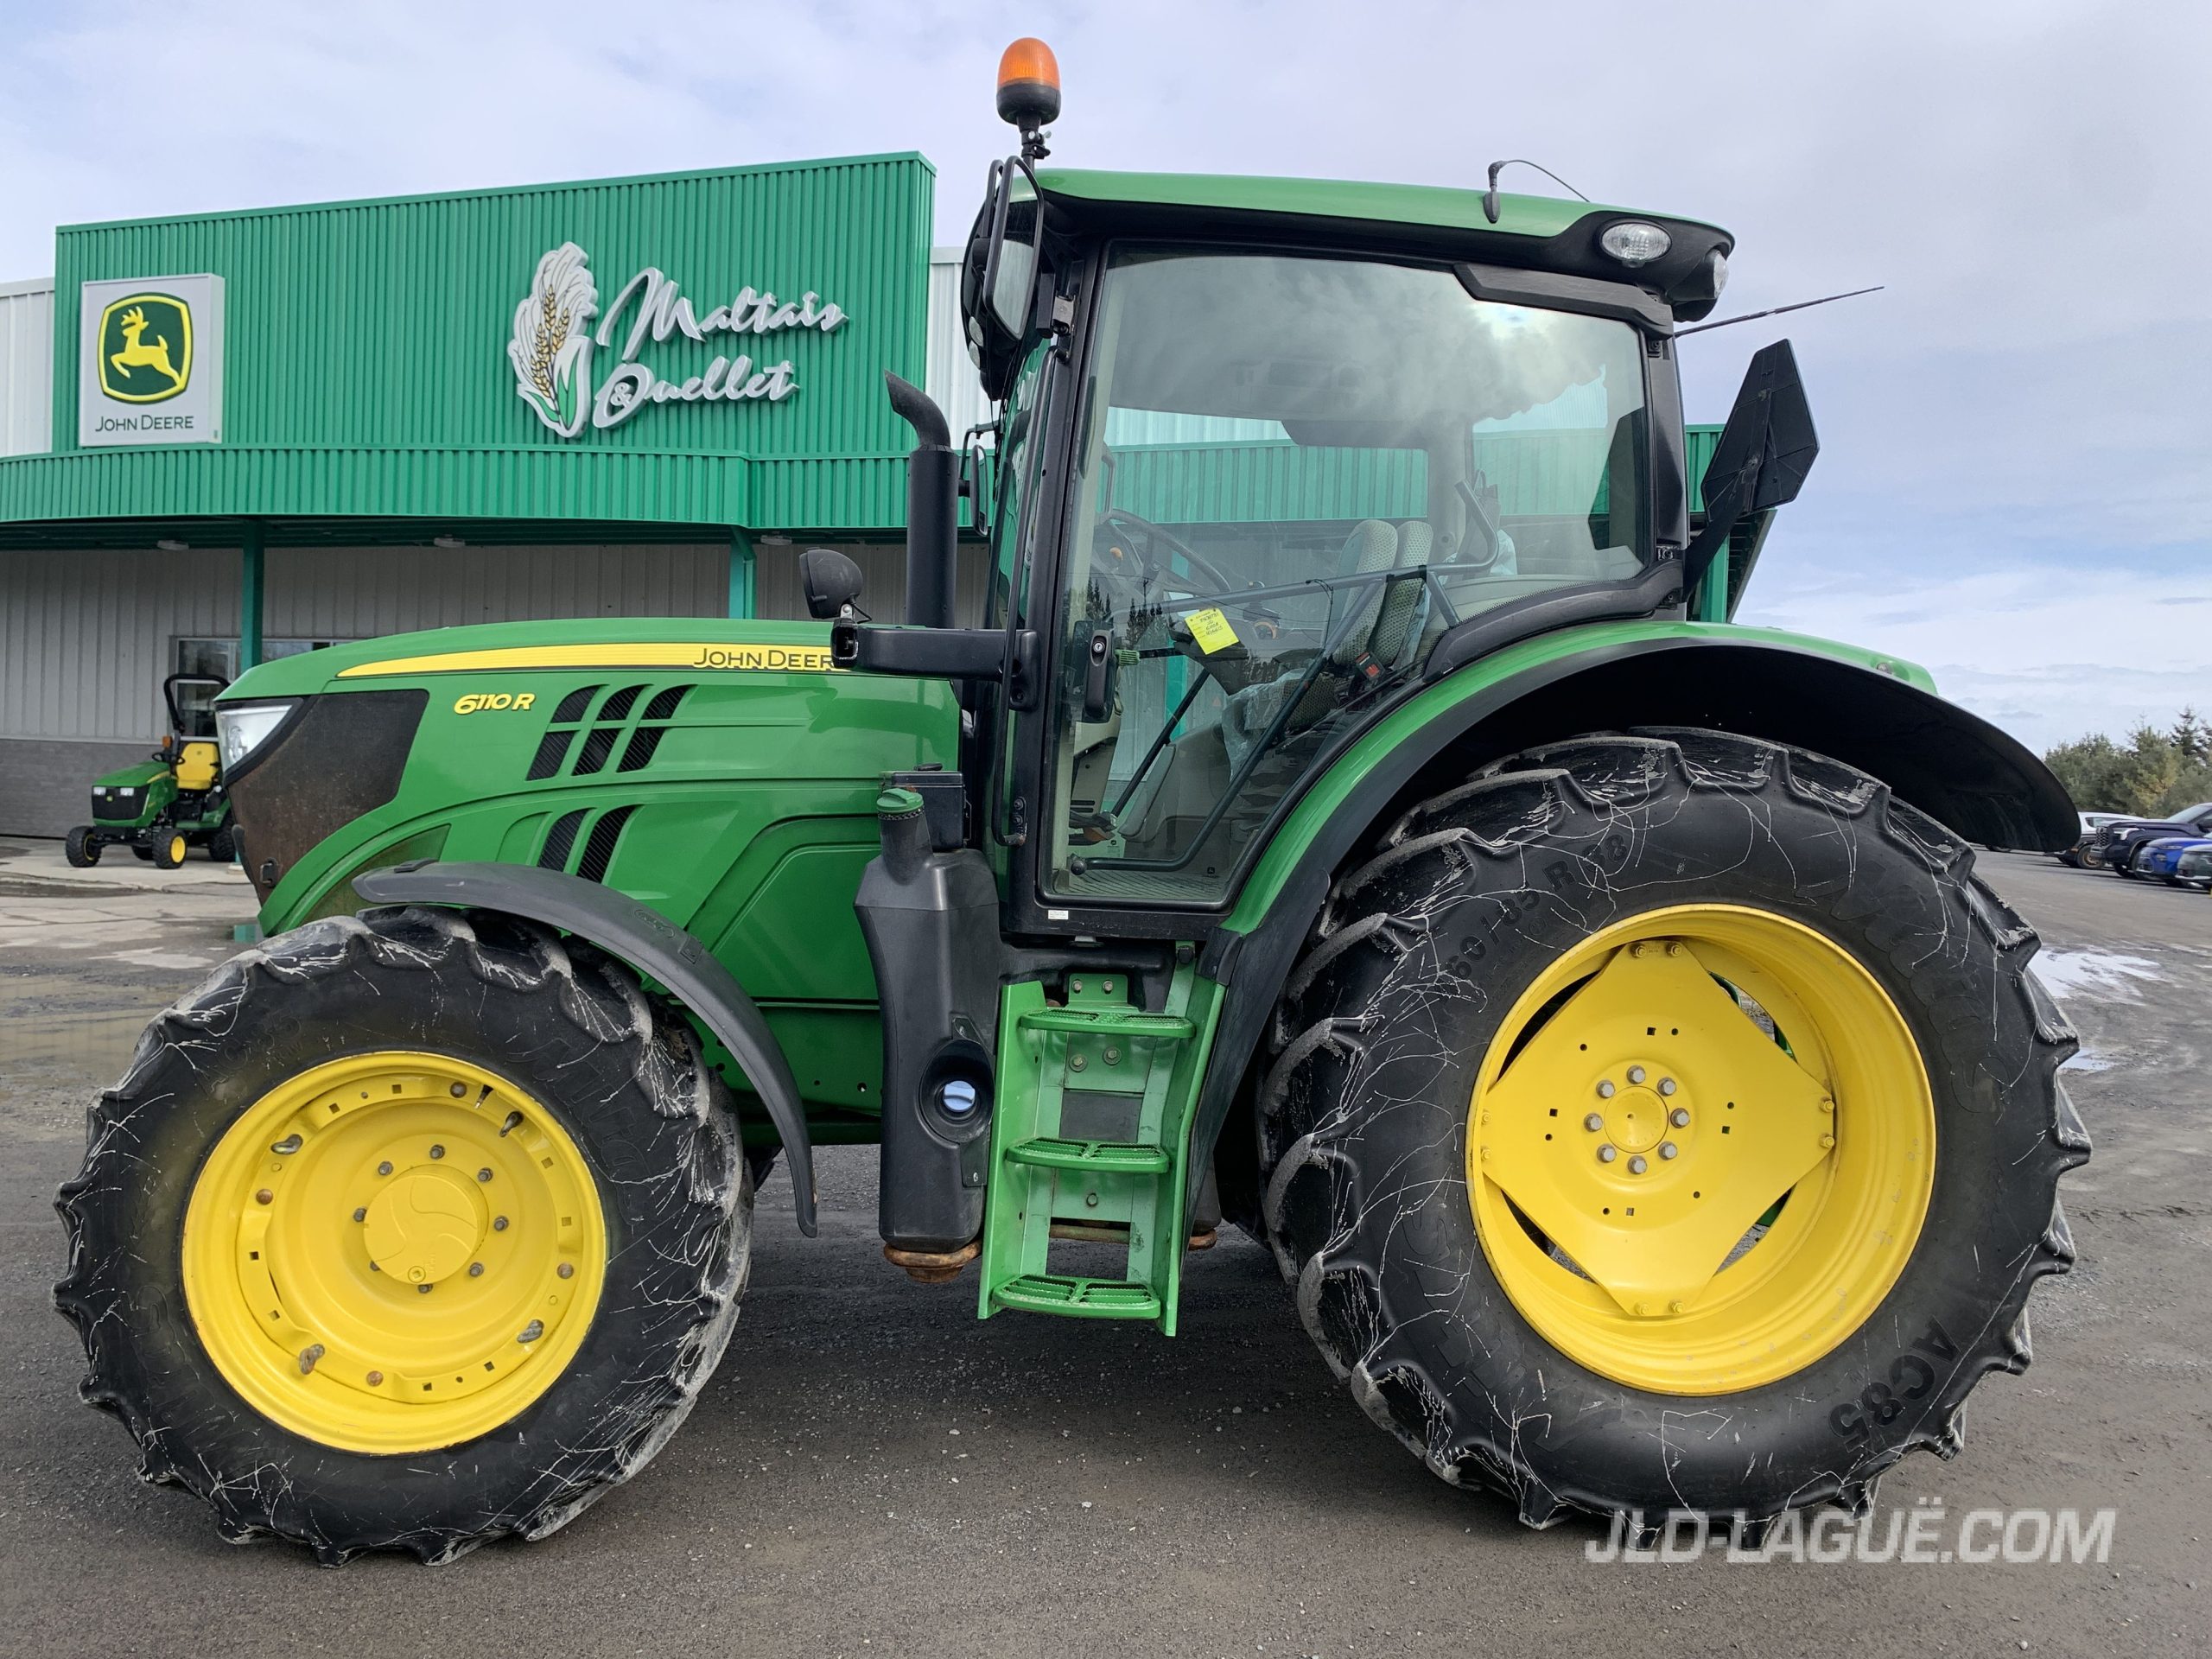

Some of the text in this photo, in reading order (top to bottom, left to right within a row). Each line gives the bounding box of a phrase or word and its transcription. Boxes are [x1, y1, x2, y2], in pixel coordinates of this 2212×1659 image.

[595, 267, 849, 363] Maltais
[95, 415, 194, 432] JOHN DEERE
[593, 353, 800, 429] Ouellet
[694, 648, 835, 669] JOHN DEER
[1828, 1314, 1961, 1453] AC85
